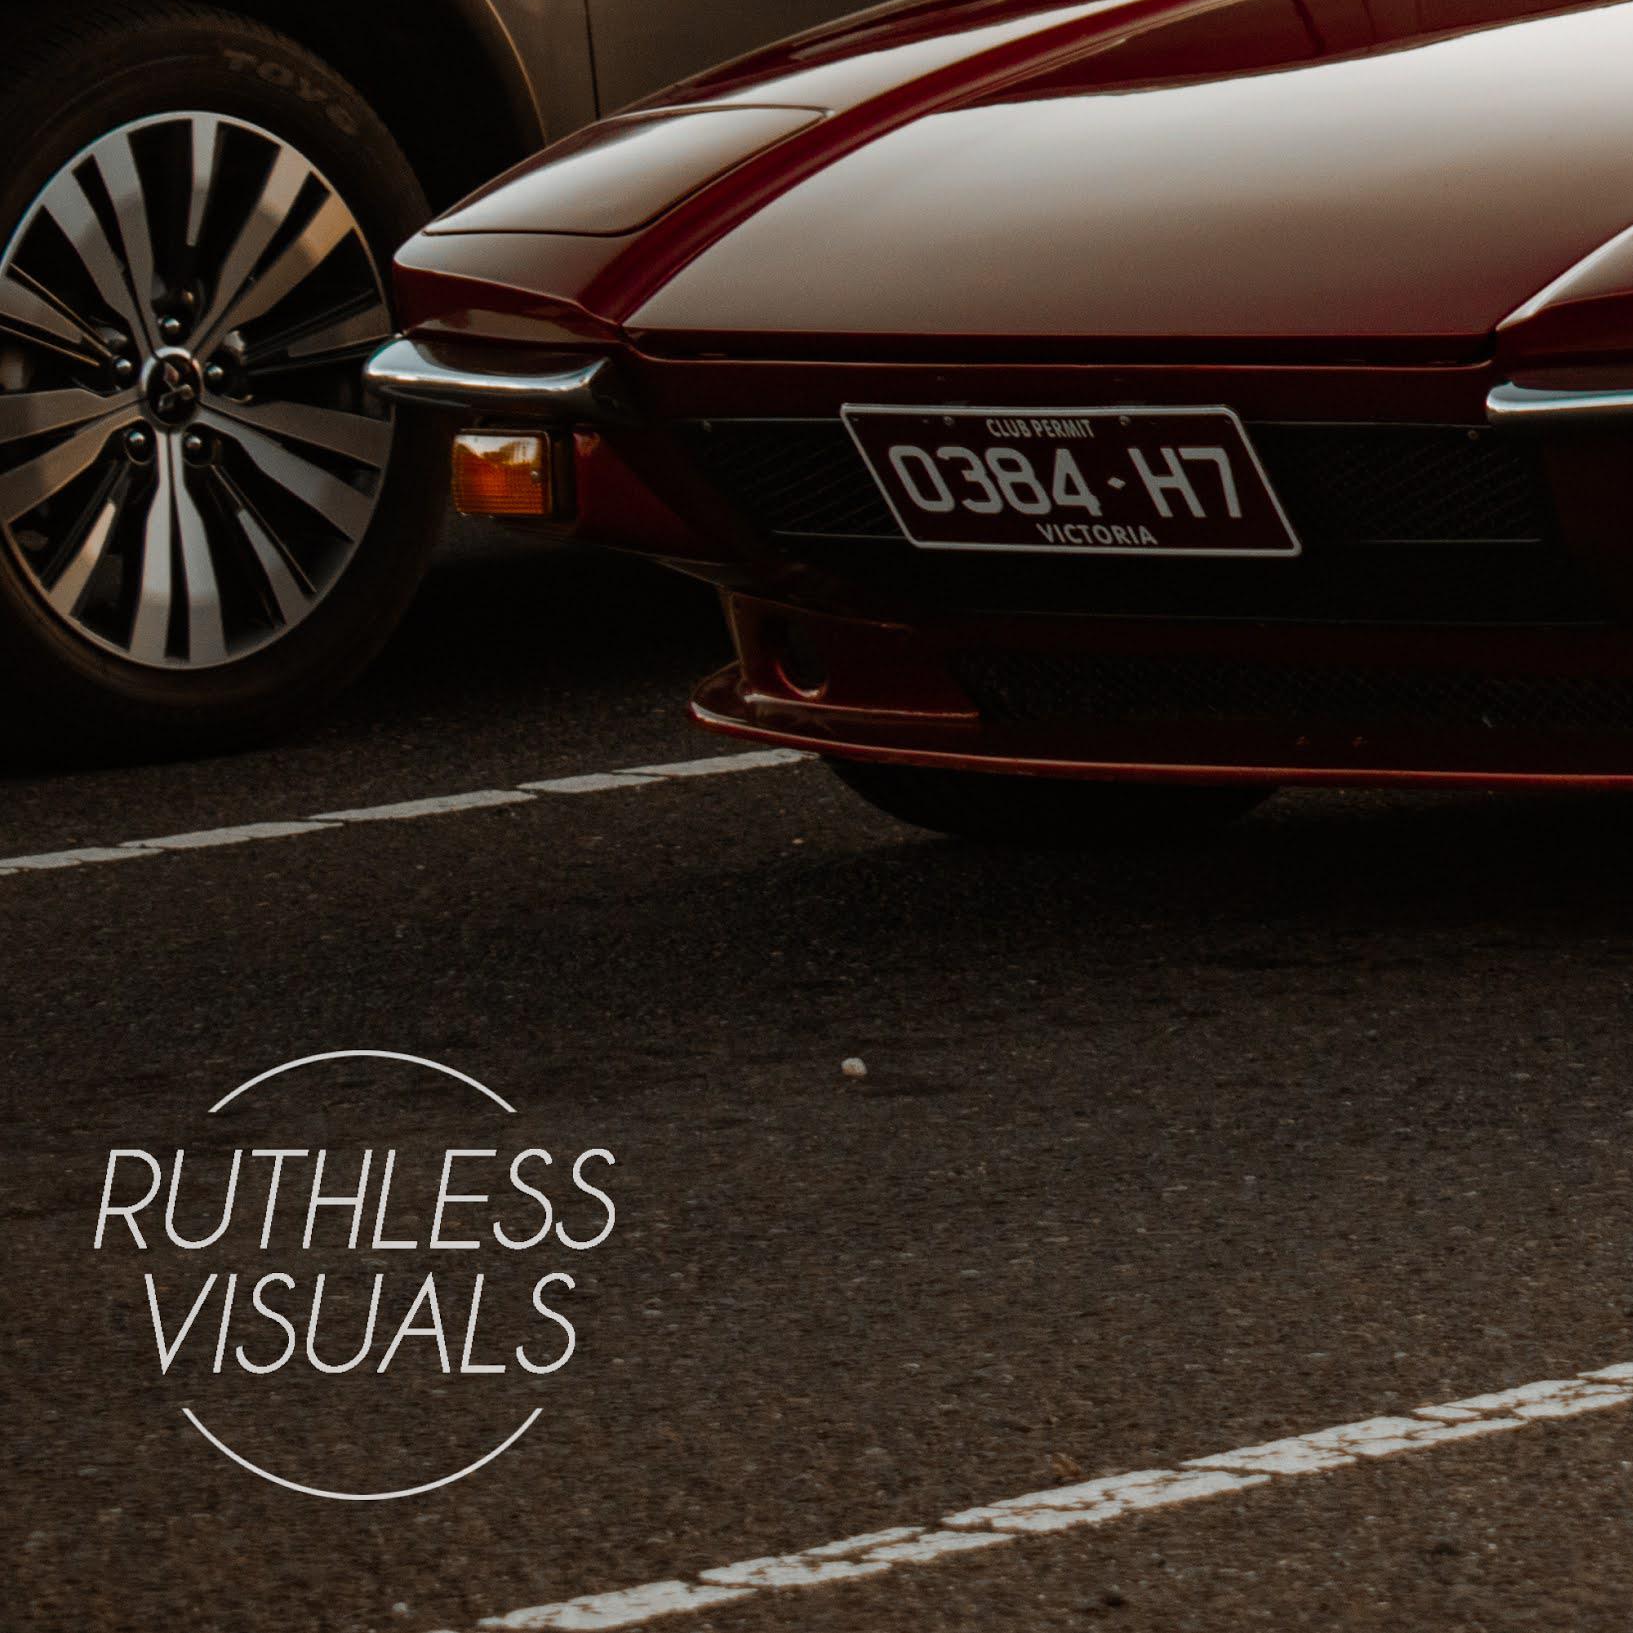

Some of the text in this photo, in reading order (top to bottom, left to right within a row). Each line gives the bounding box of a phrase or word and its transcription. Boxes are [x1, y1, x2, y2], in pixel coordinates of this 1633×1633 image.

[986, 418, 1095, 439] CLUB PERMIT
[1036, 522, 1159, 545] VICTORIA
